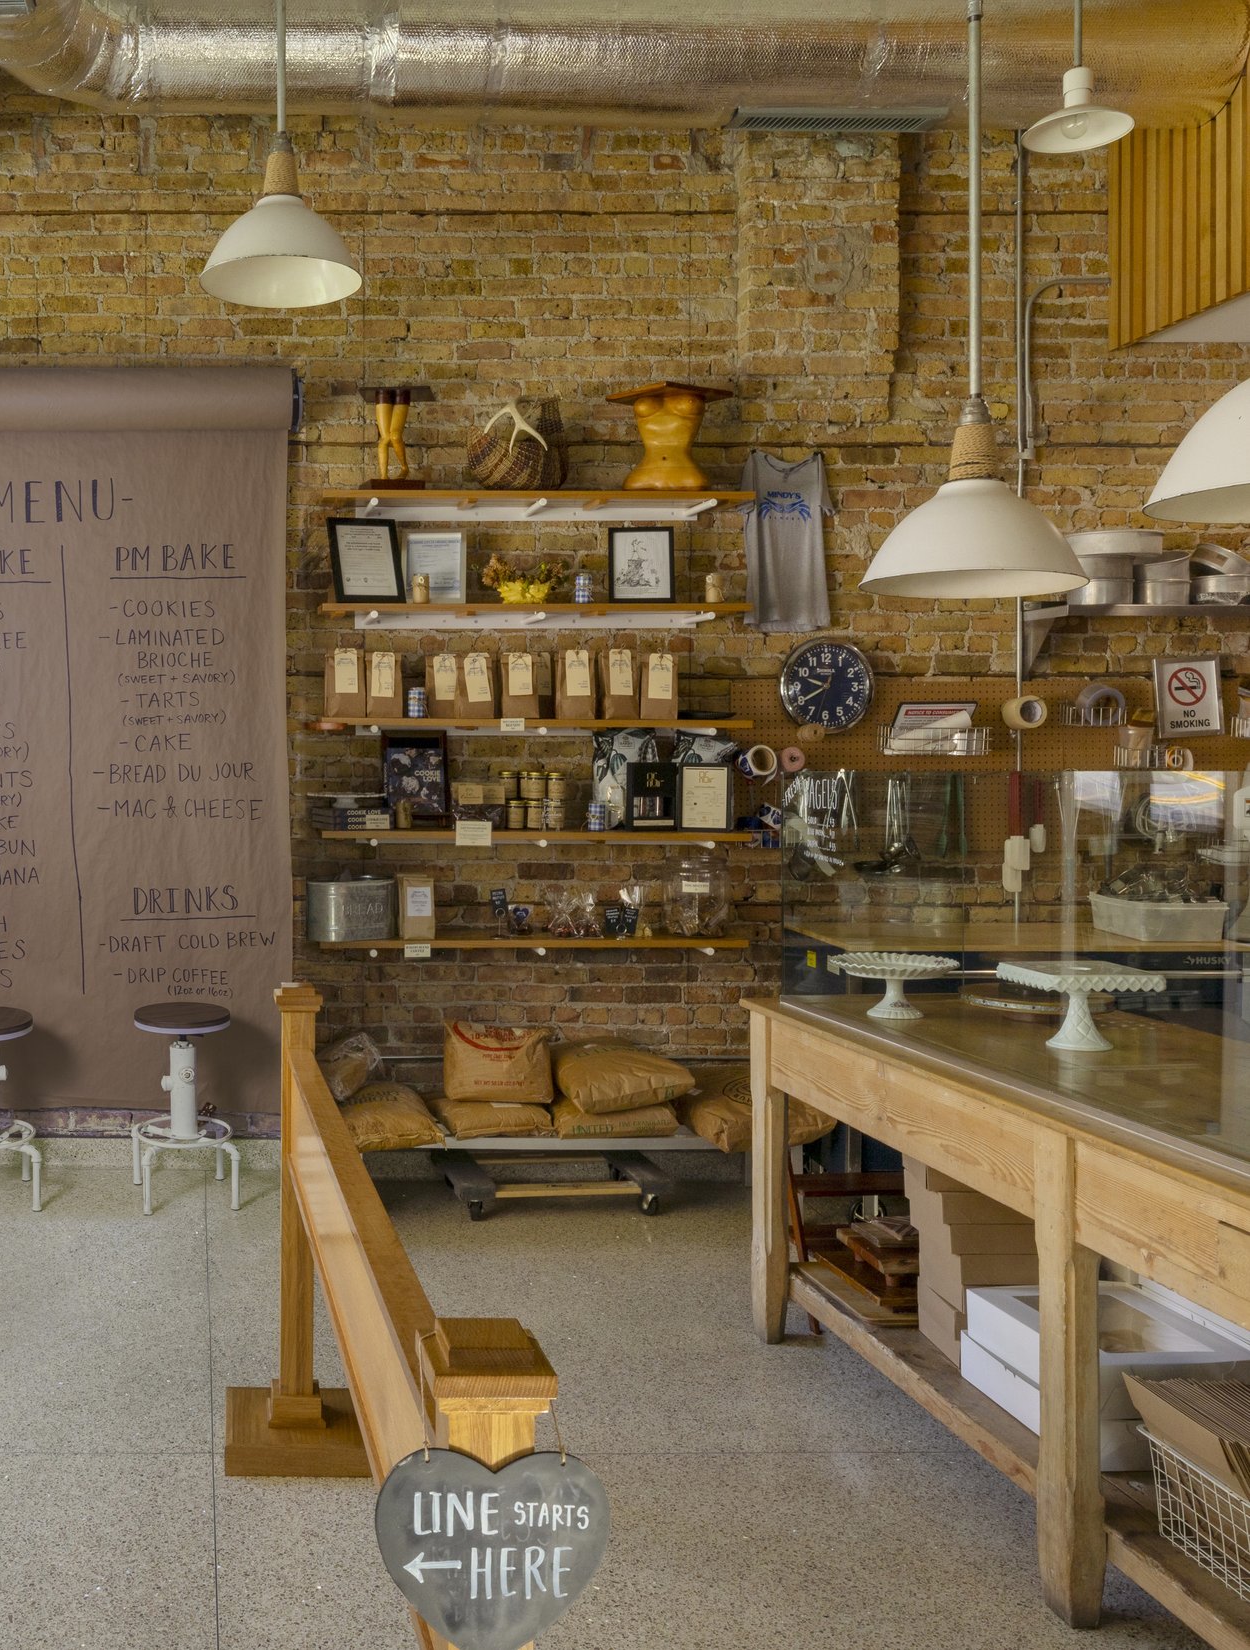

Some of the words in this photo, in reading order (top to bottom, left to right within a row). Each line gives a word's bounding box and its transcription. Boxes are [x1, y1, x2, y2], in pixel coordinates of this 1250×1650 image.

[767, 491, 801, 499] MINDY'S
[115, 546, 150, 571] PM
[162, 543, 236, 571] BAKE
[138, 651, 214, 669] BRIOCHE
[809, 657, 817, 666] 11
[821, 653, 831, 663] 12
[838, 656, 842, 667] 1
[798, 668, 809, 677] 10
[847, 668, 854, 678] 2
[118, 673, 166, 686] (SWEET
[182, 671, 236, 685] SAVORY)
[793, 682, 801, 691] 9
[851, 682, 859, 691] 3
[798, 696, 805, 705] 8
[846, 697, 853, 706] 4
[809, 706, 815, 715] 7
[822, 711, 829, 720] 6
[836, 706, 843, 716] 5
[1183, 710, 1196, 718] NO
[122, 715, 163, 727] (SWEET
[176, 712, 227, 726] SAVORY)
[1170, 719, 1211, 729] SMOKING
[178, 764, 201, 782] DU
[208, 762, 256, 780] JOUR
[167, 797, 179, 818] &
[184, 799, 263, 821] CHEESE
[133, 885, 239, 916] DRINKS
[179, 933, 220, 950] COLD
[226, 931, 276, 949] BREW
[1196, 956, 1231, 965] HUSKY
[171, 968, 228, 985] COFFEE
[413, 1491, 499, 1537] LINE
[514, 1502, 589, 1531] STARTS
[470, 1546, 573, 1600] HERE
